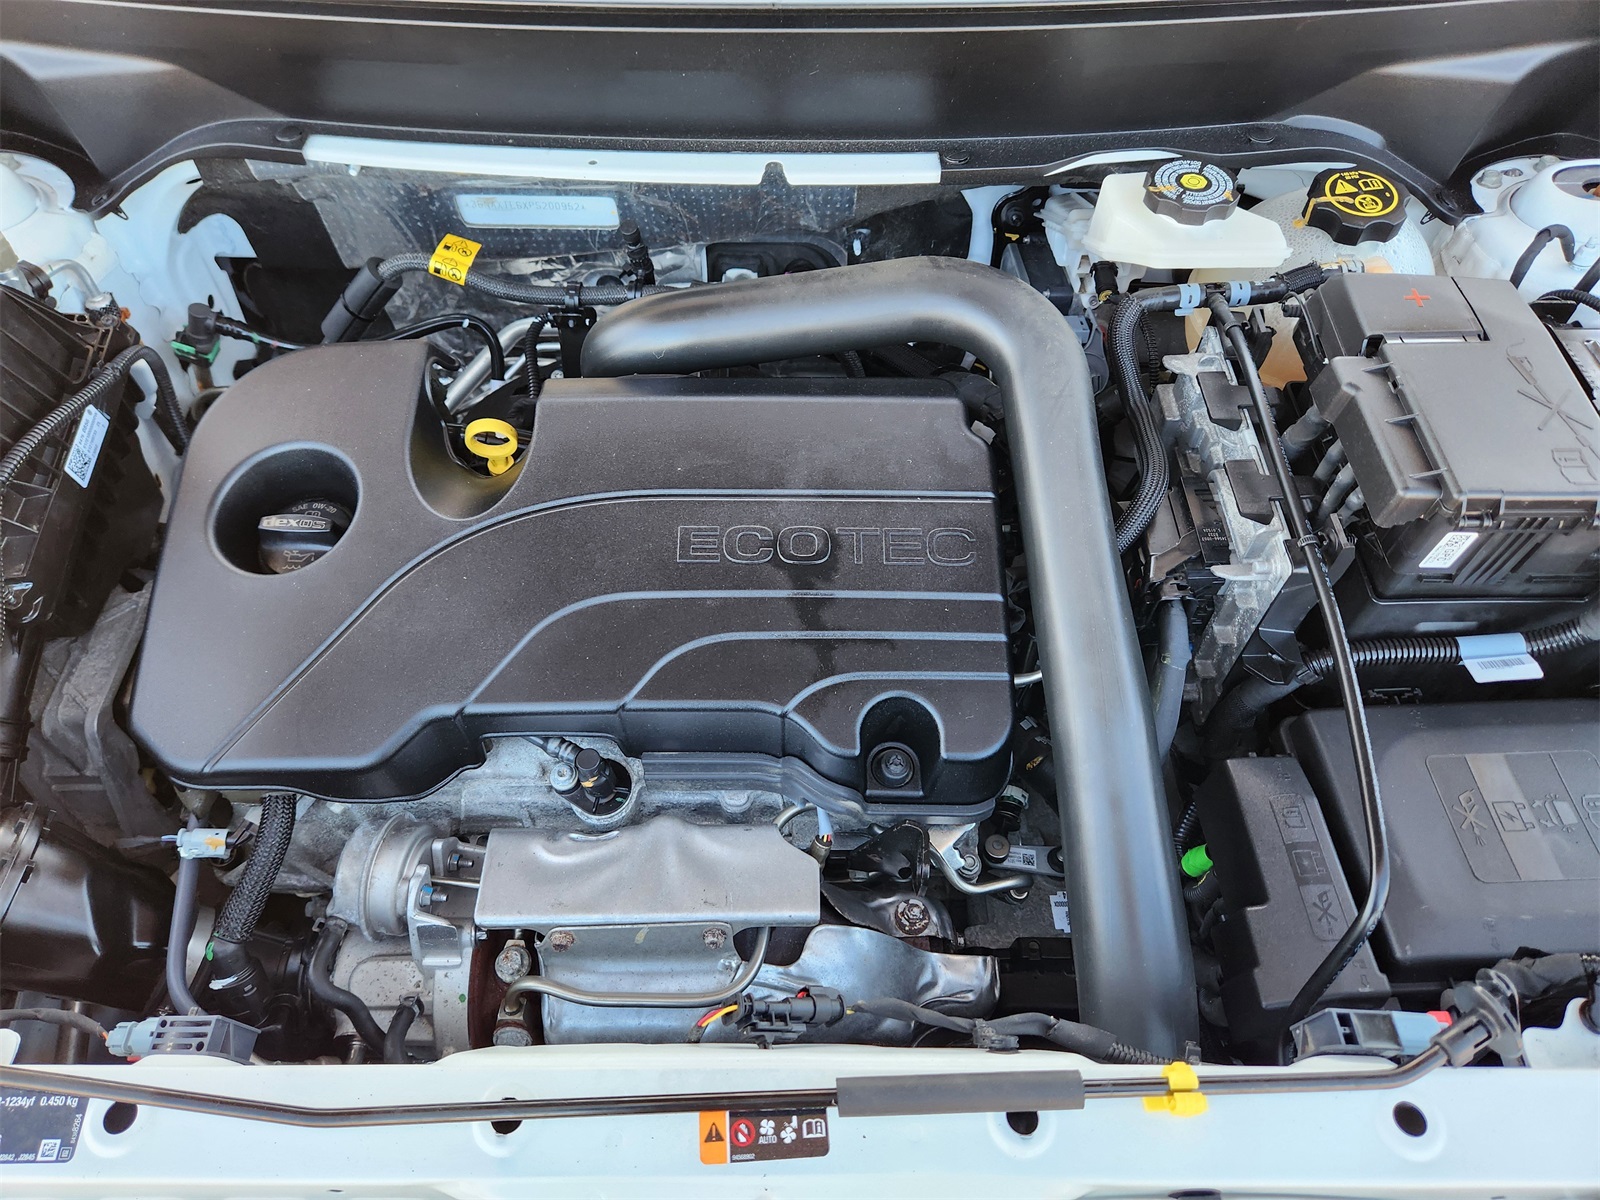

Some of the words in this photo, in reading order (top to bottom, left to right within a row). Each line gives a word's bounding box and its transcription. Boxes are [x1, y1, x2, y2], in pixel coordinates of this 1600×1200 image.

[292, 503, 308, 512] SAE
[312, 503, 337, 514] 0W-20
[262, 517, 326, 529] dexos
[677, 525, 976, 566] ECOTEC
[40, 1096, 65, 1106] 0.450
[66, 1096, 79, 1108] kg
[758, 1135, 777, 1144] AUTO
